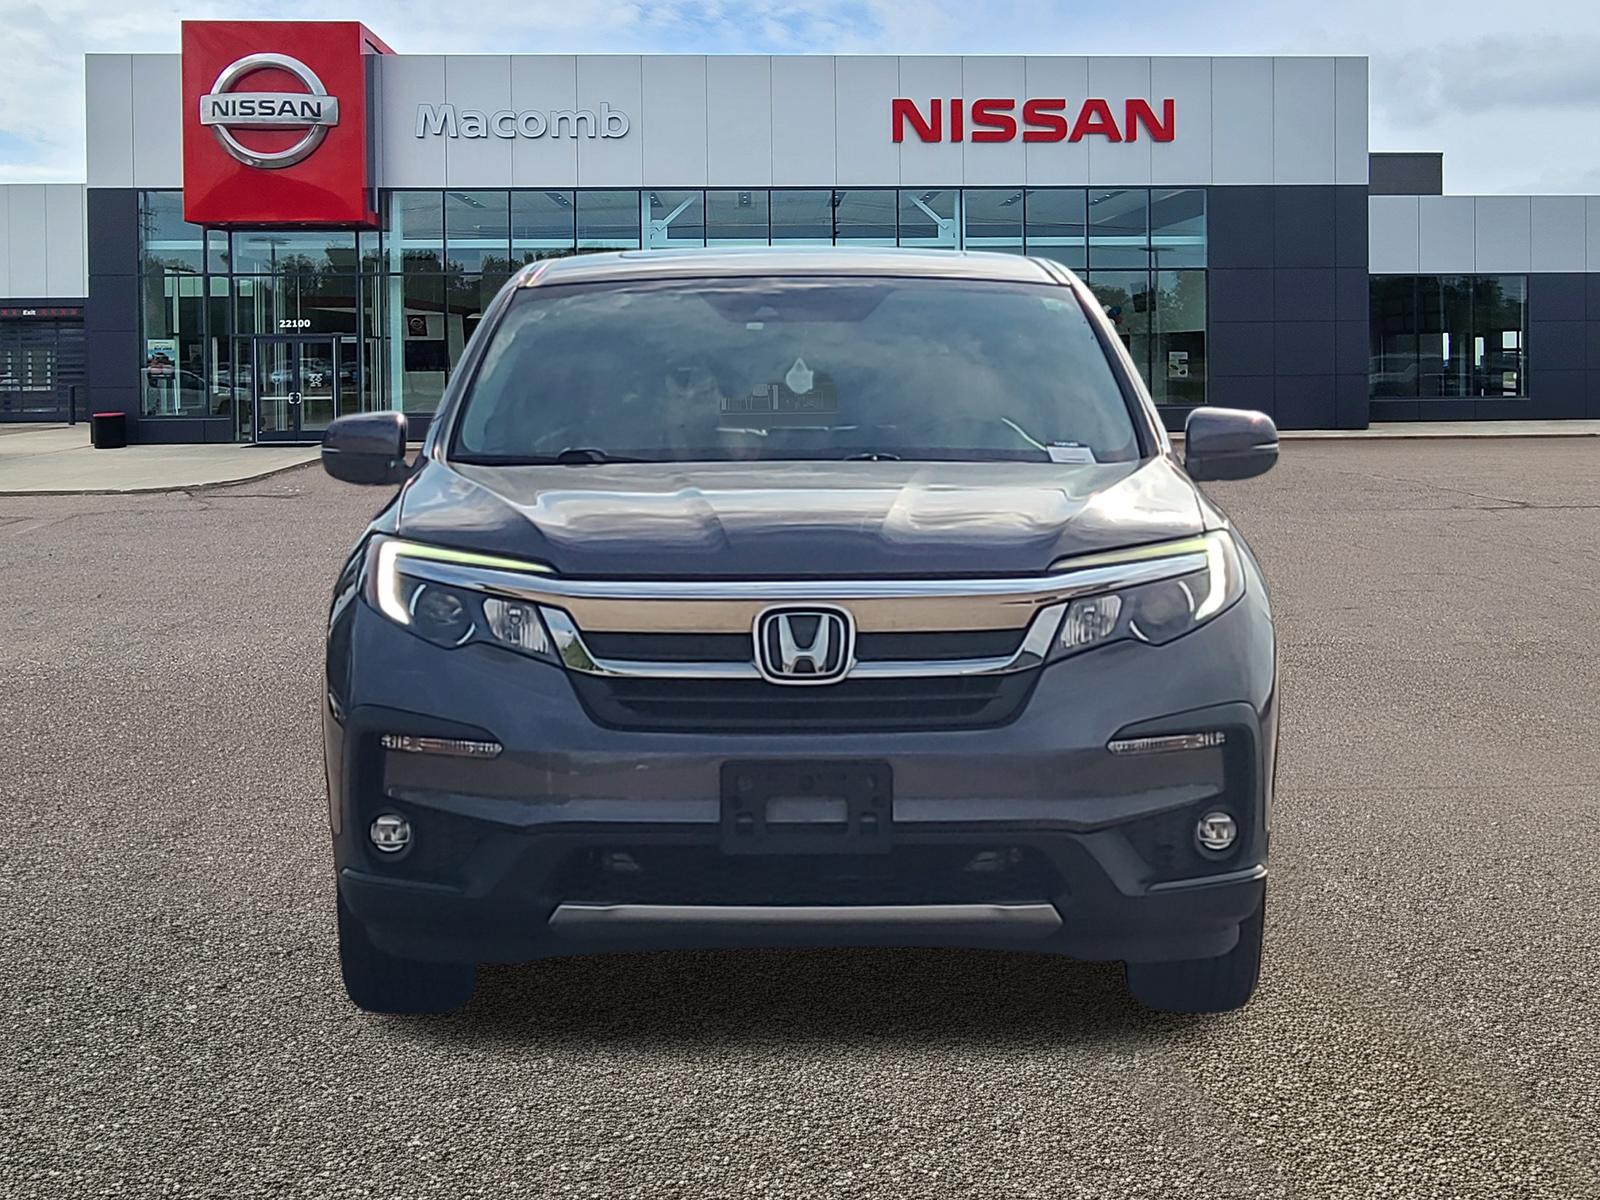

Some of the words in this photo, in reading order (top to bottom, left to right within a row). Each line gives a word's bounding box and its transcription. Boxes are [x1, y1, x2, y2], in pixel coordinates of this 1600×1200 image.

[211, 100, 322, 117] NISSAN
[415, 102, 630, 139] Macomb
[891, 98, 1176, 143] NISSAN
[279, 319, 311, 328] 22100
